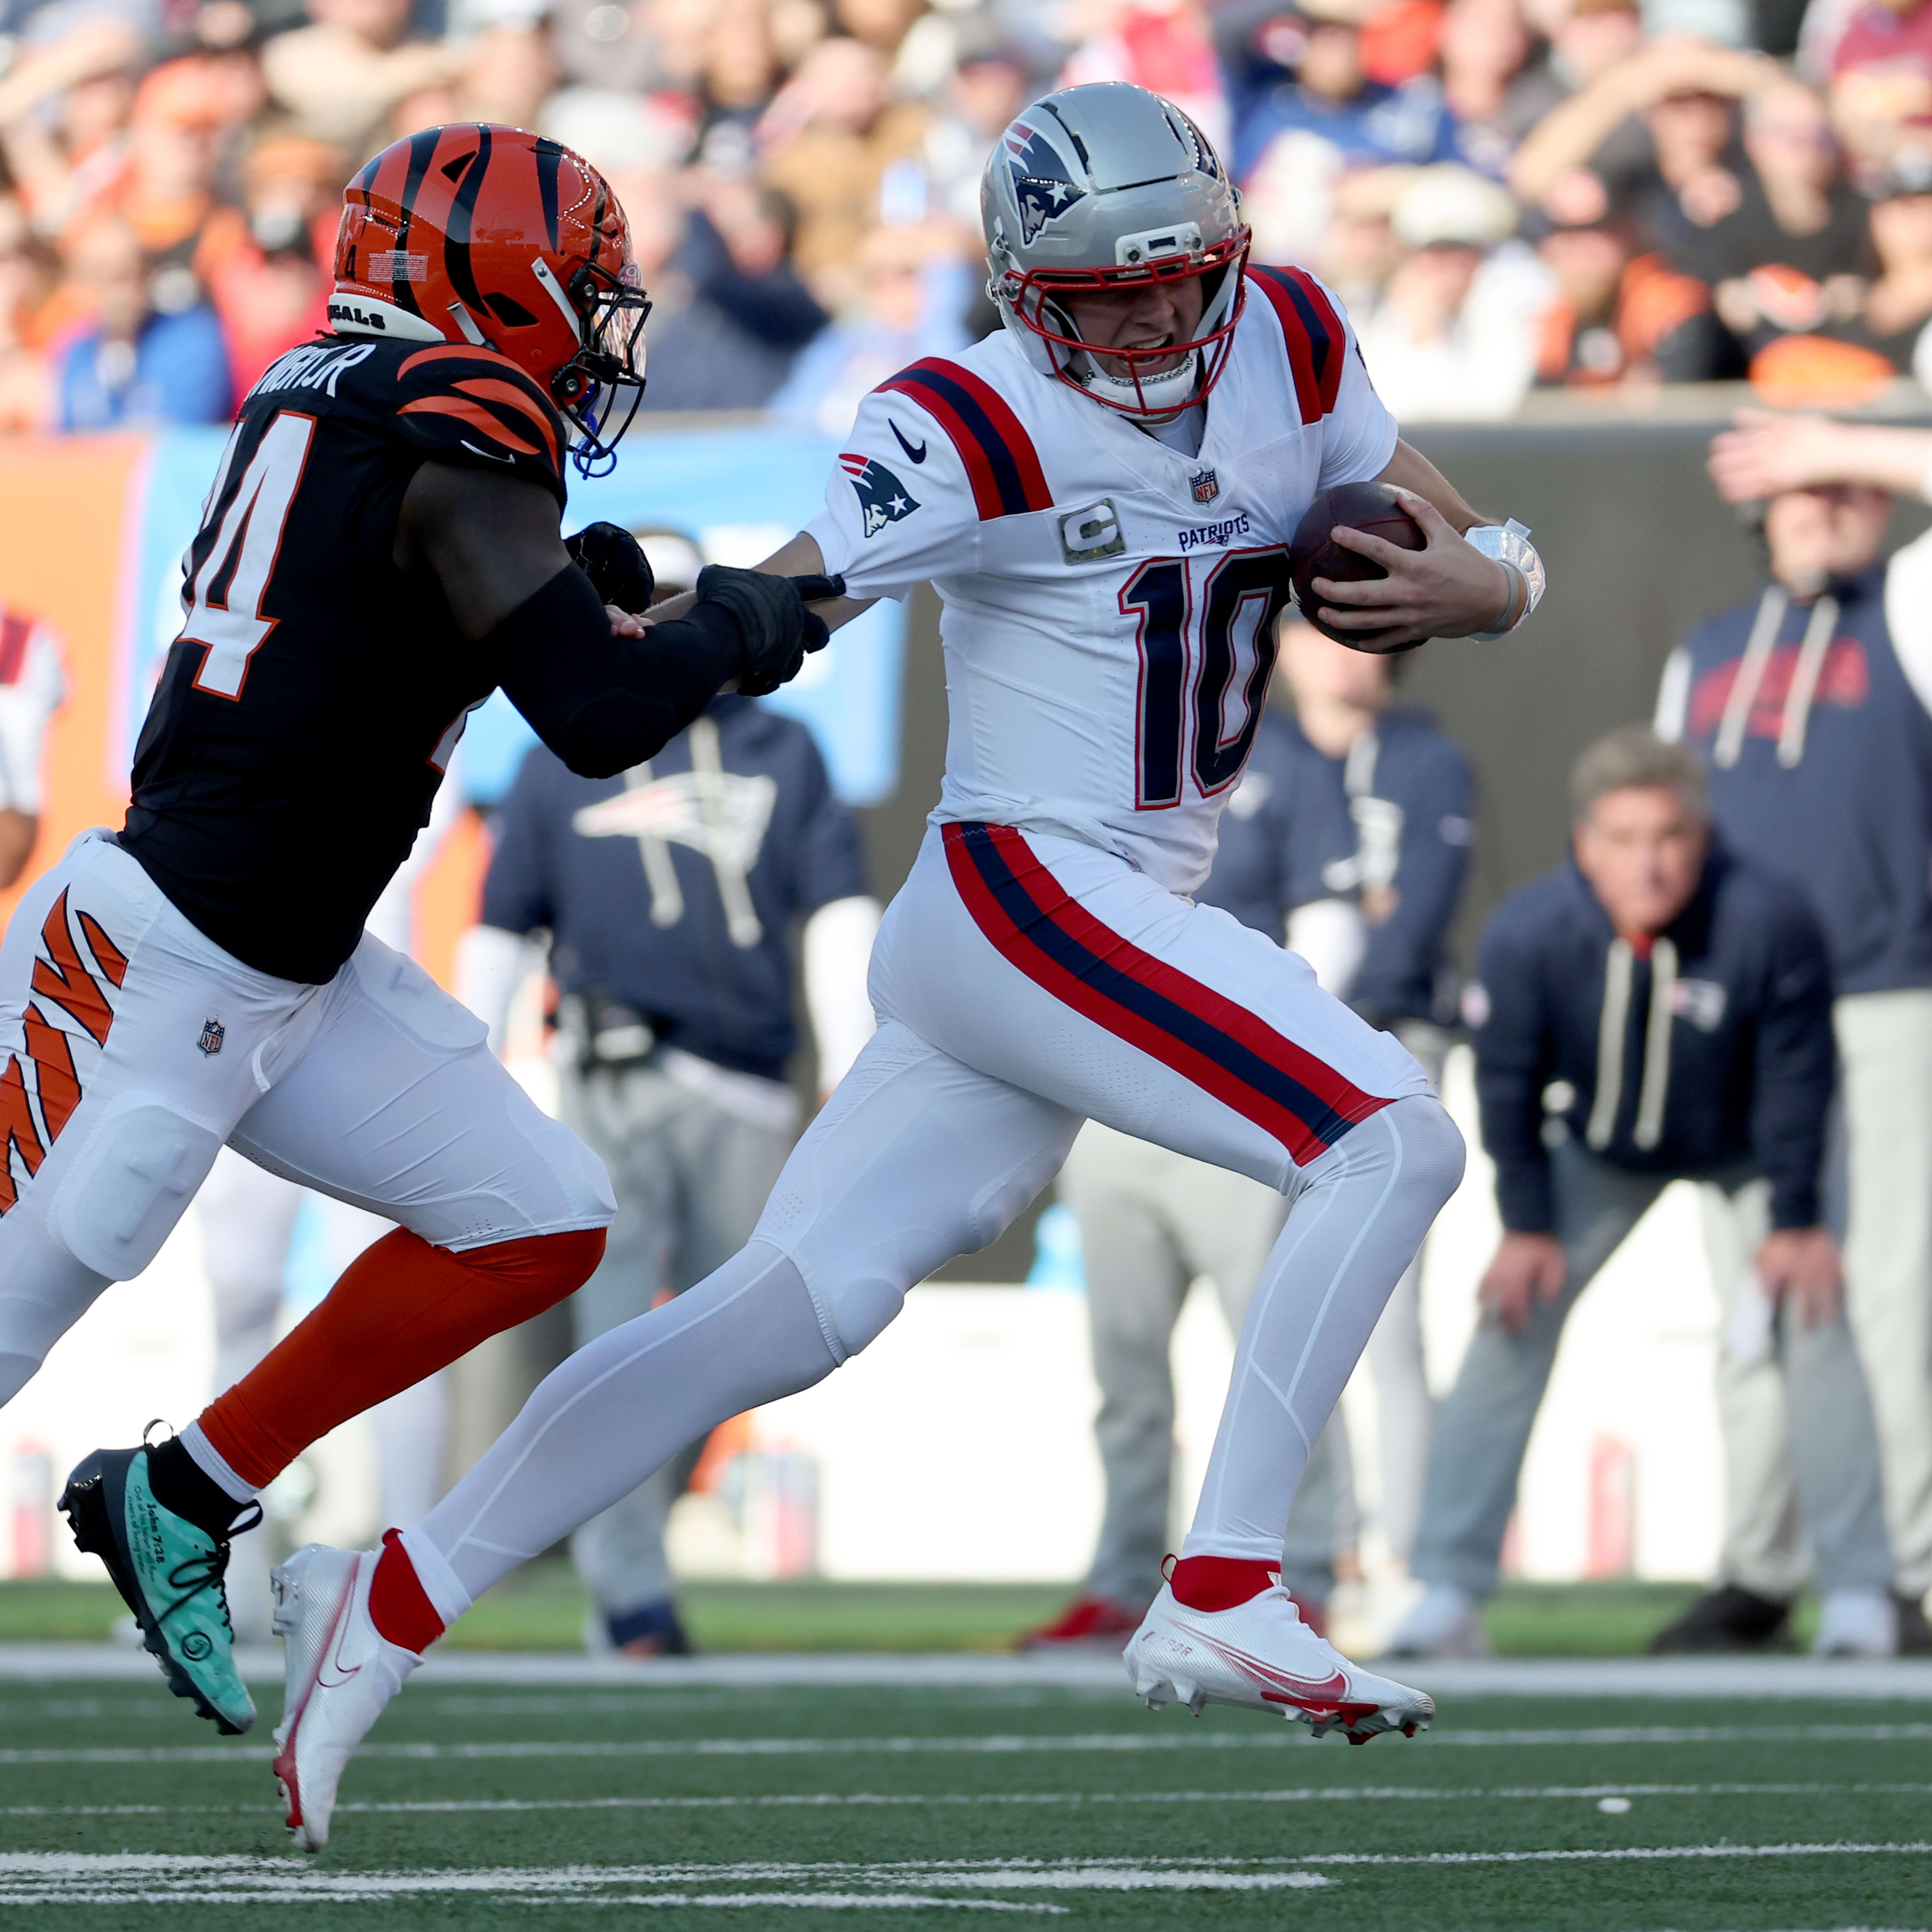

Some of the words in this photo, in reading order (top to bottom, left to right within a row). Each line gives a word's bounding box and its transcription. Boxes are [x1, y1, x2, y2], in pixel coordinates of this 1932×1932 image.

[1195, 484, 1216, 500] NFL
[1064, 505, 1117, 551] C
[1178, 513, 1249, 552] PATRIOTS
[1118, 543, 1290, 811] 10
[201, 1032, 219, 1051] NFL
[147, 1503, 159, 1533] John
